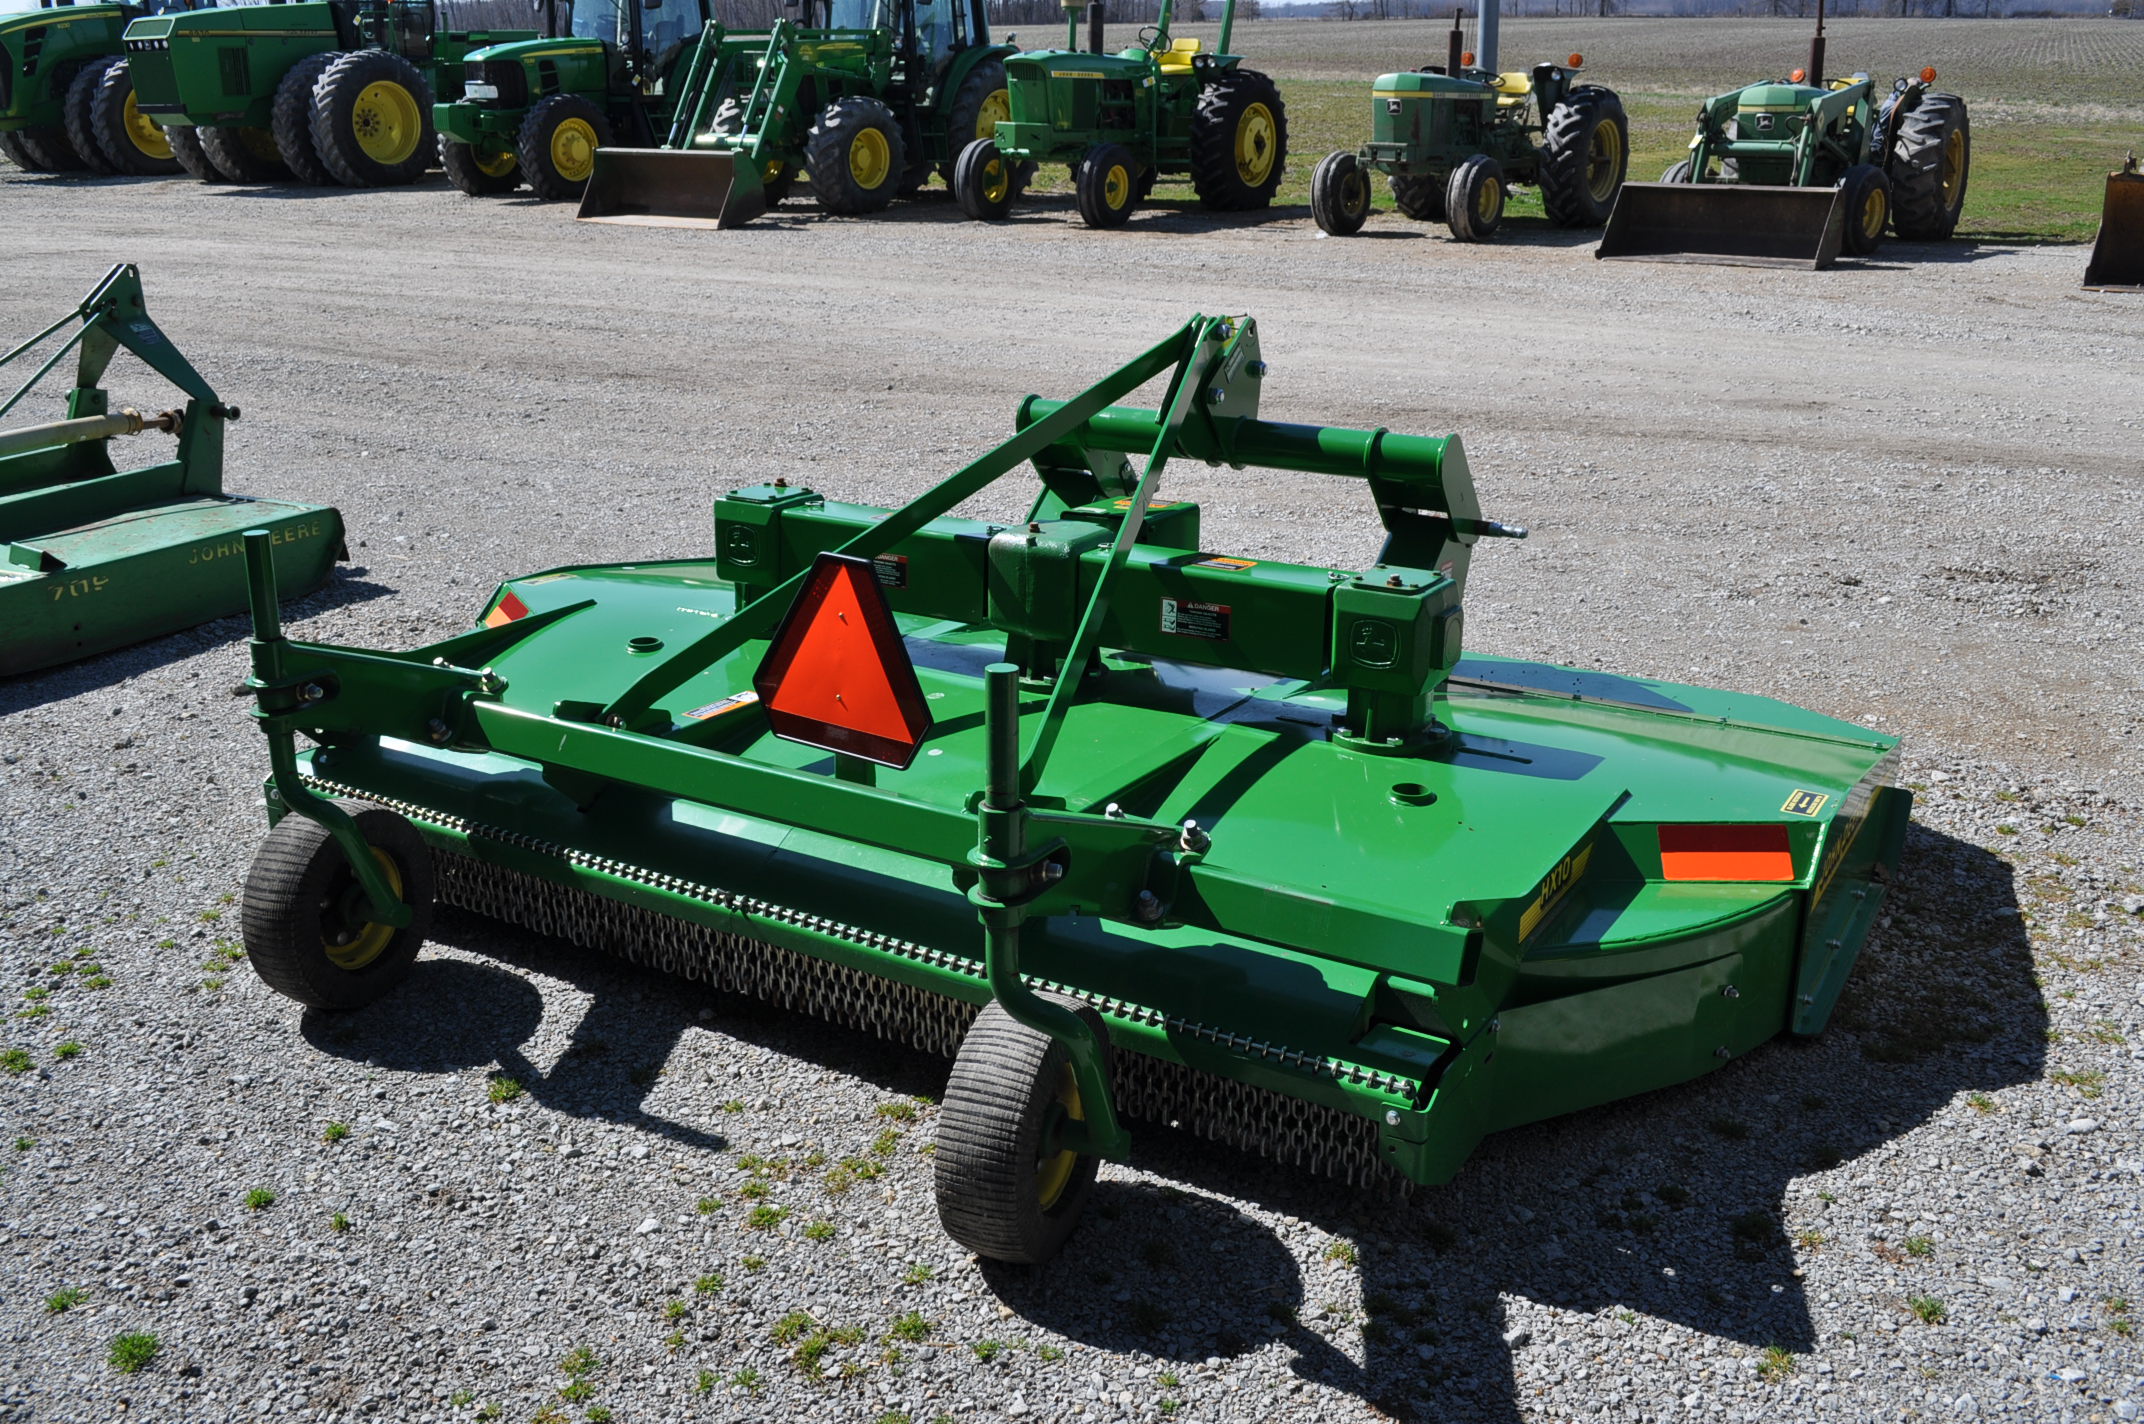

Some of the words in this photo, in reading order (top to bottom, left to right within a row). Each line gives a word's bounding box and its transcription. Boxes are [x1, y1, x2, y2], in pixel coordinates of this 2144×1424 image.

[188, 541, 245, 565] JOHN
[270, 520, 321, 545] EERE
[1195, 603, 1220, 612] DANGER
[1540, 855, 1571, 905] HX10
